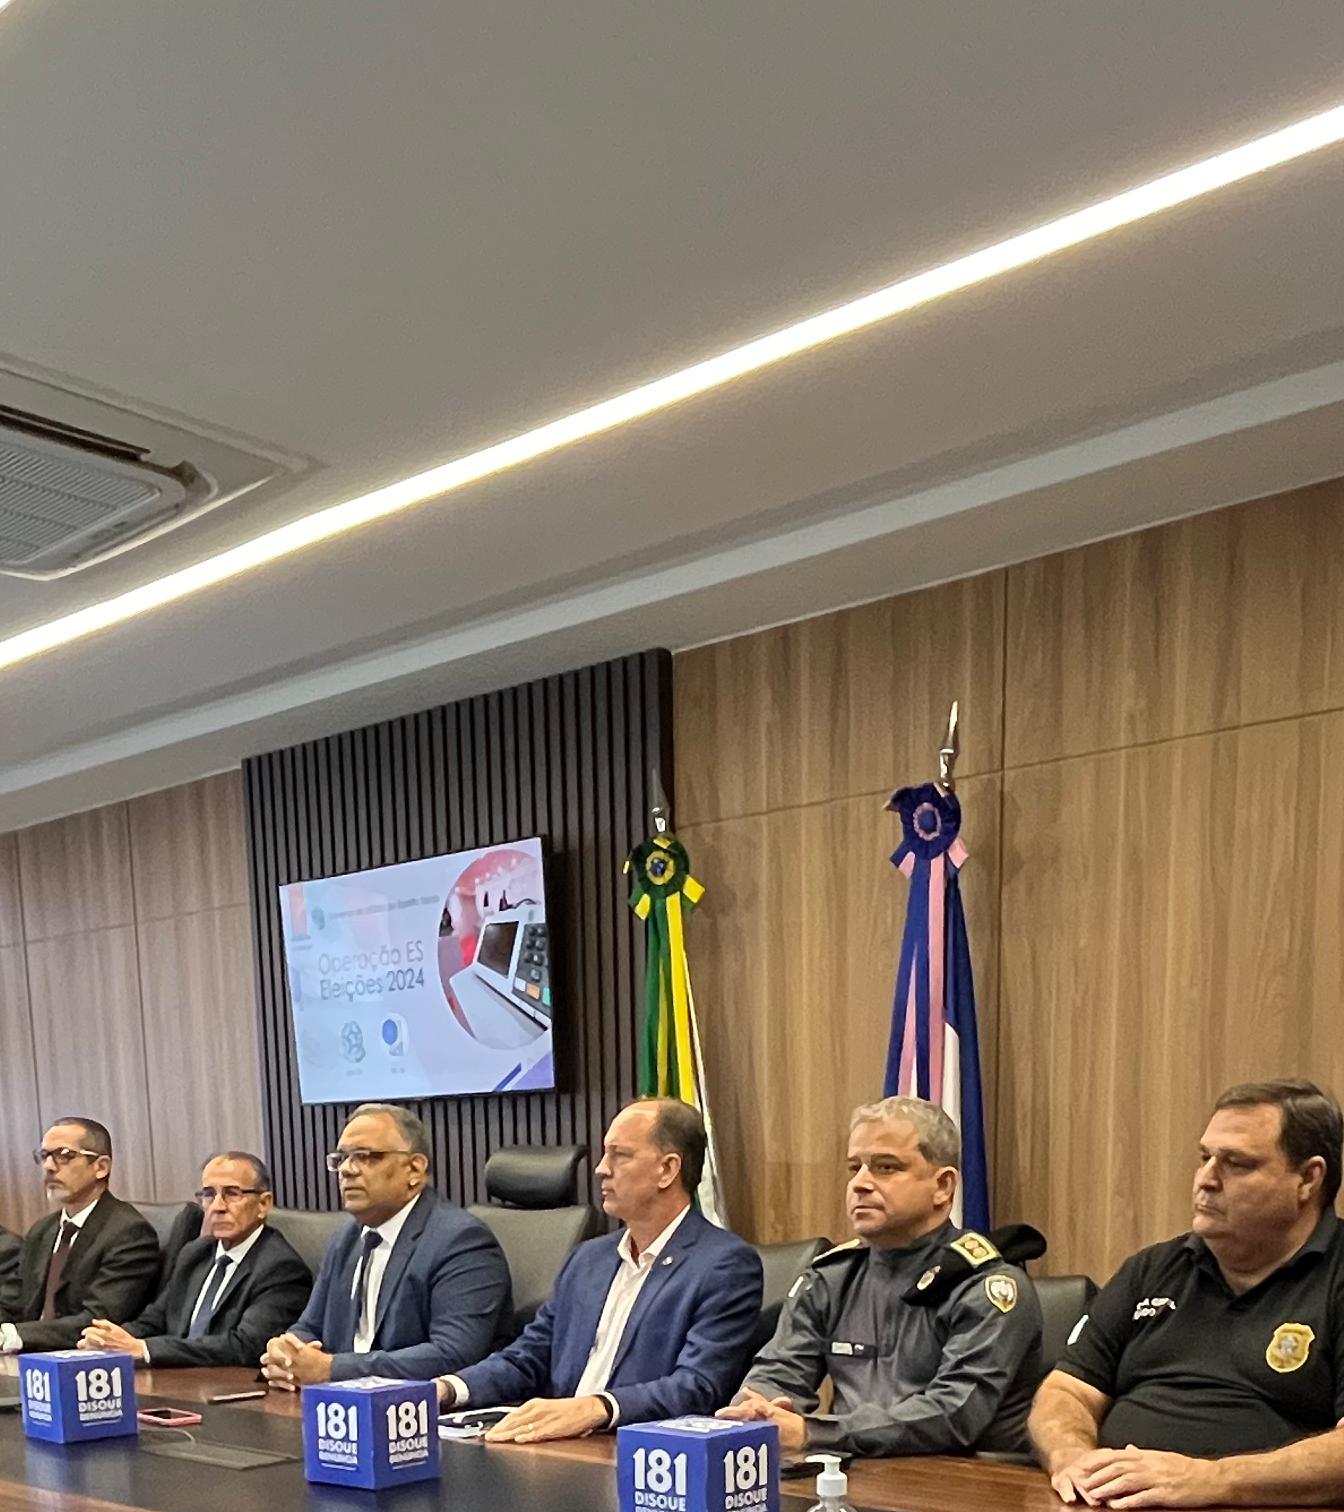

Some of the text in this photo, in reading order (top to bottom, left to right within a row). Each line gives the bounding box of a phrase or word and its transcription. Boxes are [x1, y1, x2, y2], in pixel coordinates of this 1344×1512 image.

[406, 940, 424, 962] ES
[386, 968, 424, 992] 2024
[26, 1368, 51, 1402] 181
[75, 1367, 123, 1401] 181
[316, 1402, 358, 1441] 181
[386, 1400, 429, 1440] 181
[633, 1448, 687, 1496] 181
[724, 1443, 768, 1493] 181
[635, 1490, 687, 1512] DISQUE
[725, 1488, 768, 1510] DISQUE
